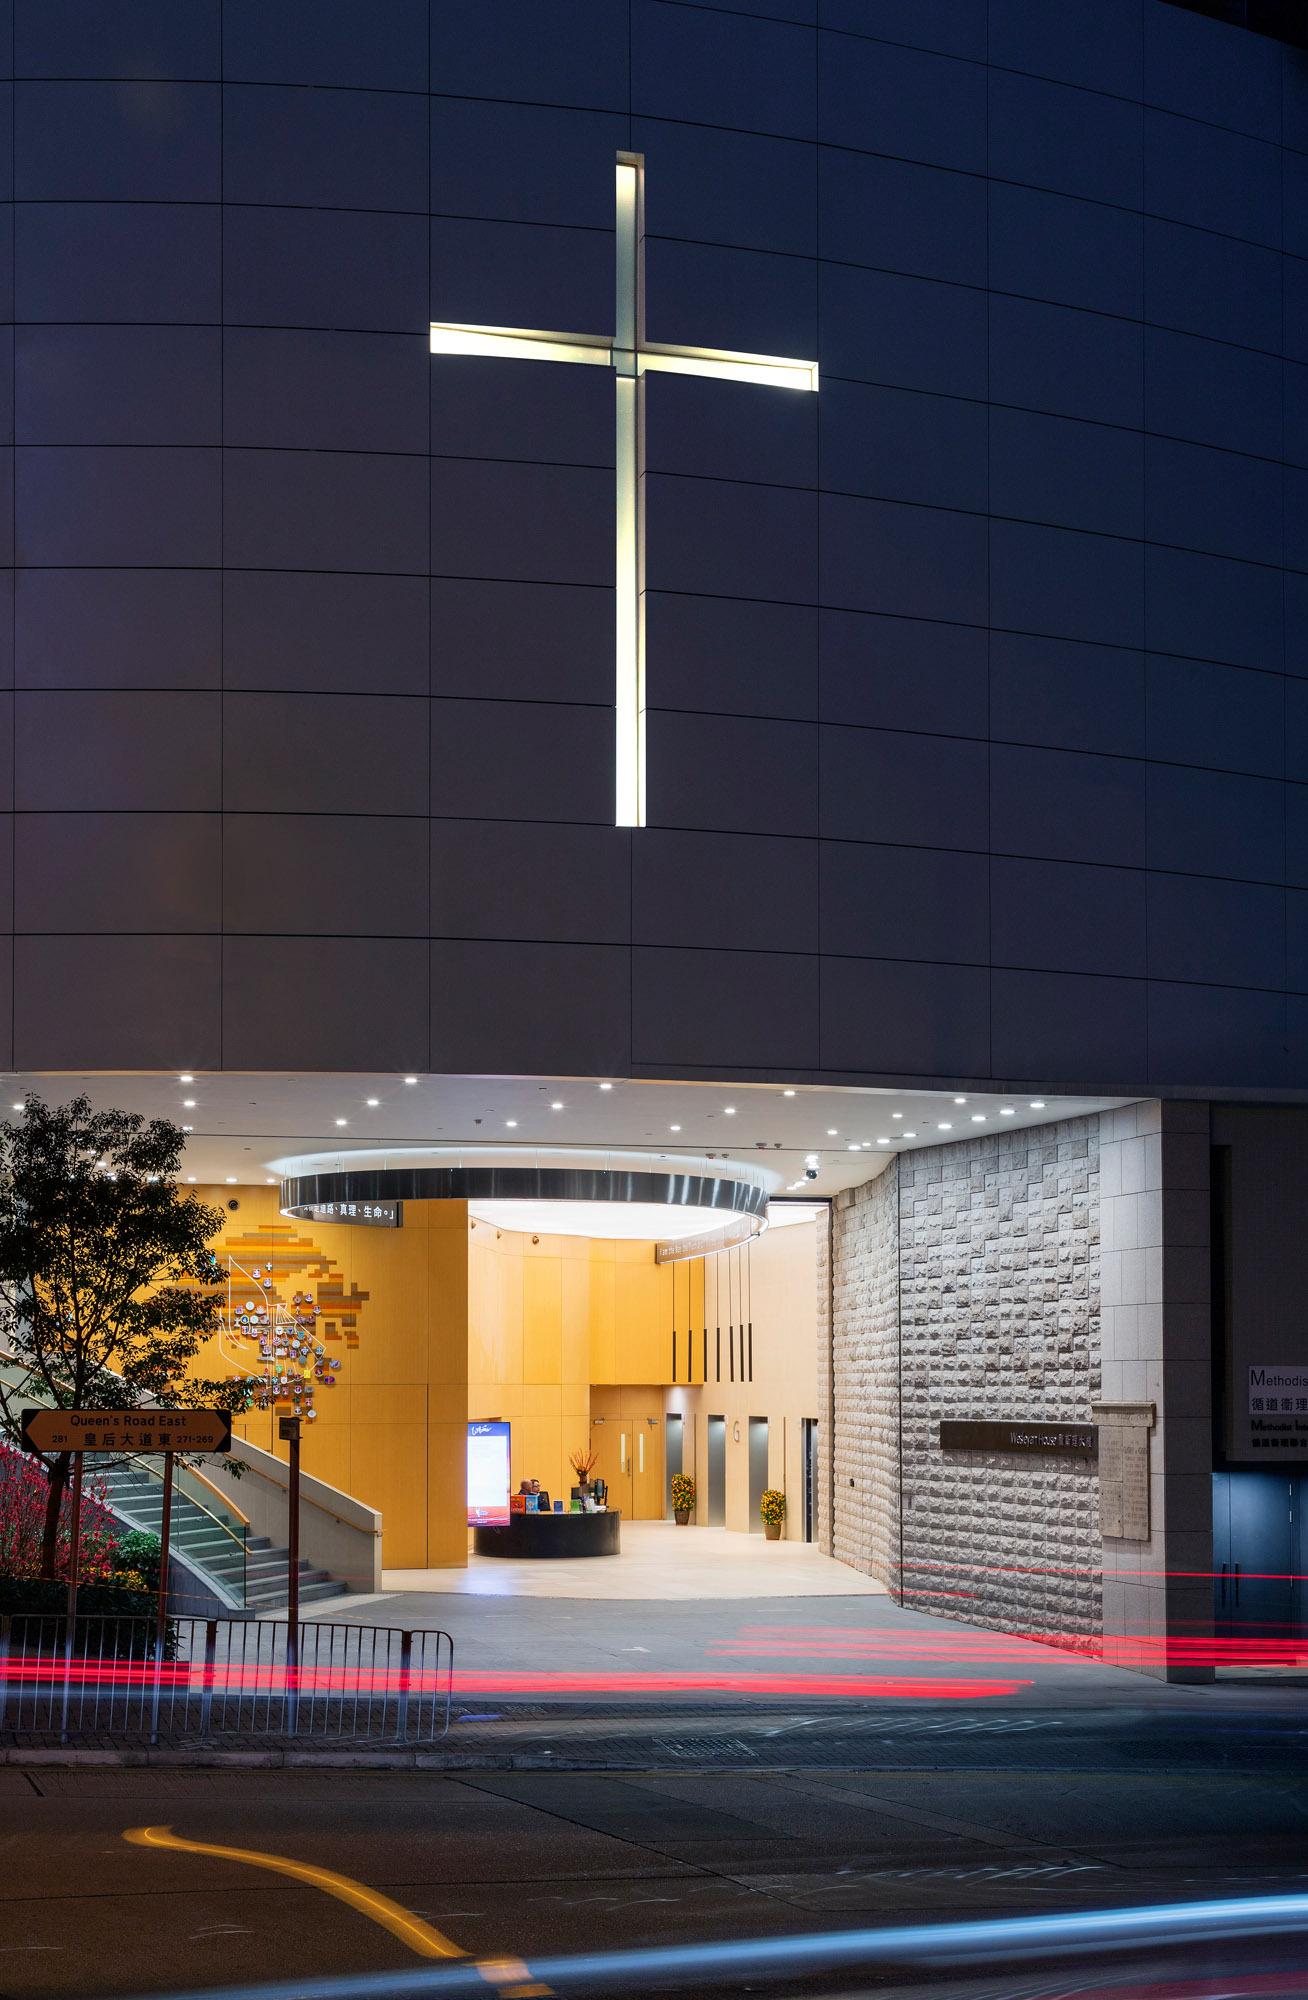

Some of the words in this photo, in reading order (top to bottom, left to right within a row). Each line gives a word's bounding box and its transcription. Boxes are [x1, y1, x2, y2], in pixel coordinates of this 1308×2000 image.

[70, 1414, 119, 1427] Queen's
[124, 1415, 155, 1427] Road
[159, 1415, 187, 1427] East
[1250, 1420, 1292, 1432] Methodist
[733, 1421, 740, 1442] G
[51, 1435, 68, 1443] 281
[83, 1432, 172, 1447] 皇后大道東
[176, 1435, 214, 1443] 271-269
[1010, 1432, 1037, 1447] Wesleyan
[1039, 1434, 1056, 1446] House
